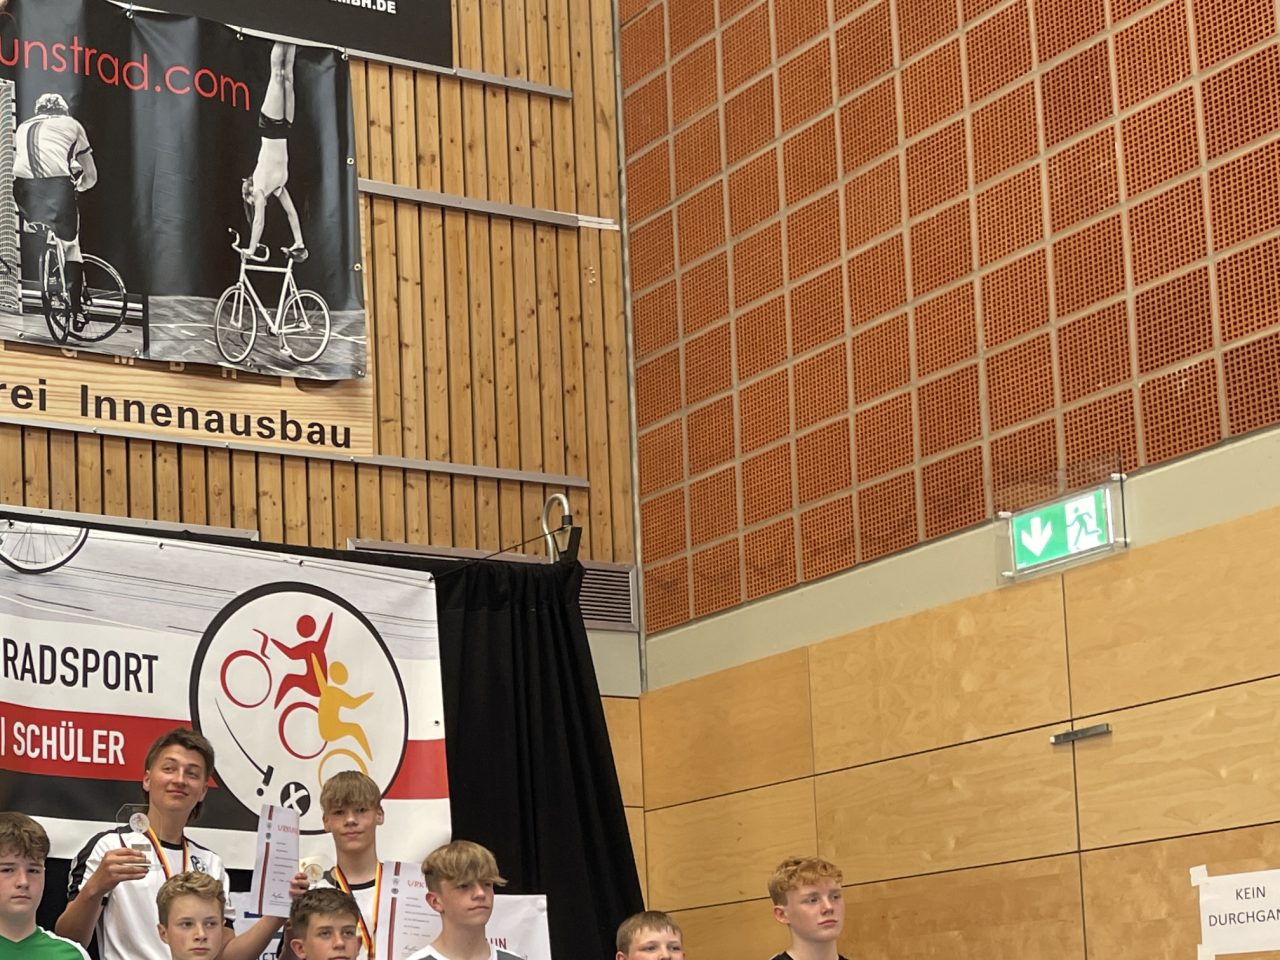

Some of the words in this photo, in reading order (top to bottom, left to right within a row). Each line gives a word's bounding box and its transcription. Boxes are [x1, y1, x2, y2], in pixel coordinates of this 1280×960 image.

[80, 384, 351, 449] Innenausbau
[13, 719, 125, 766] SCHÜLER
[1235, 886, 1266, 901] KEIN
